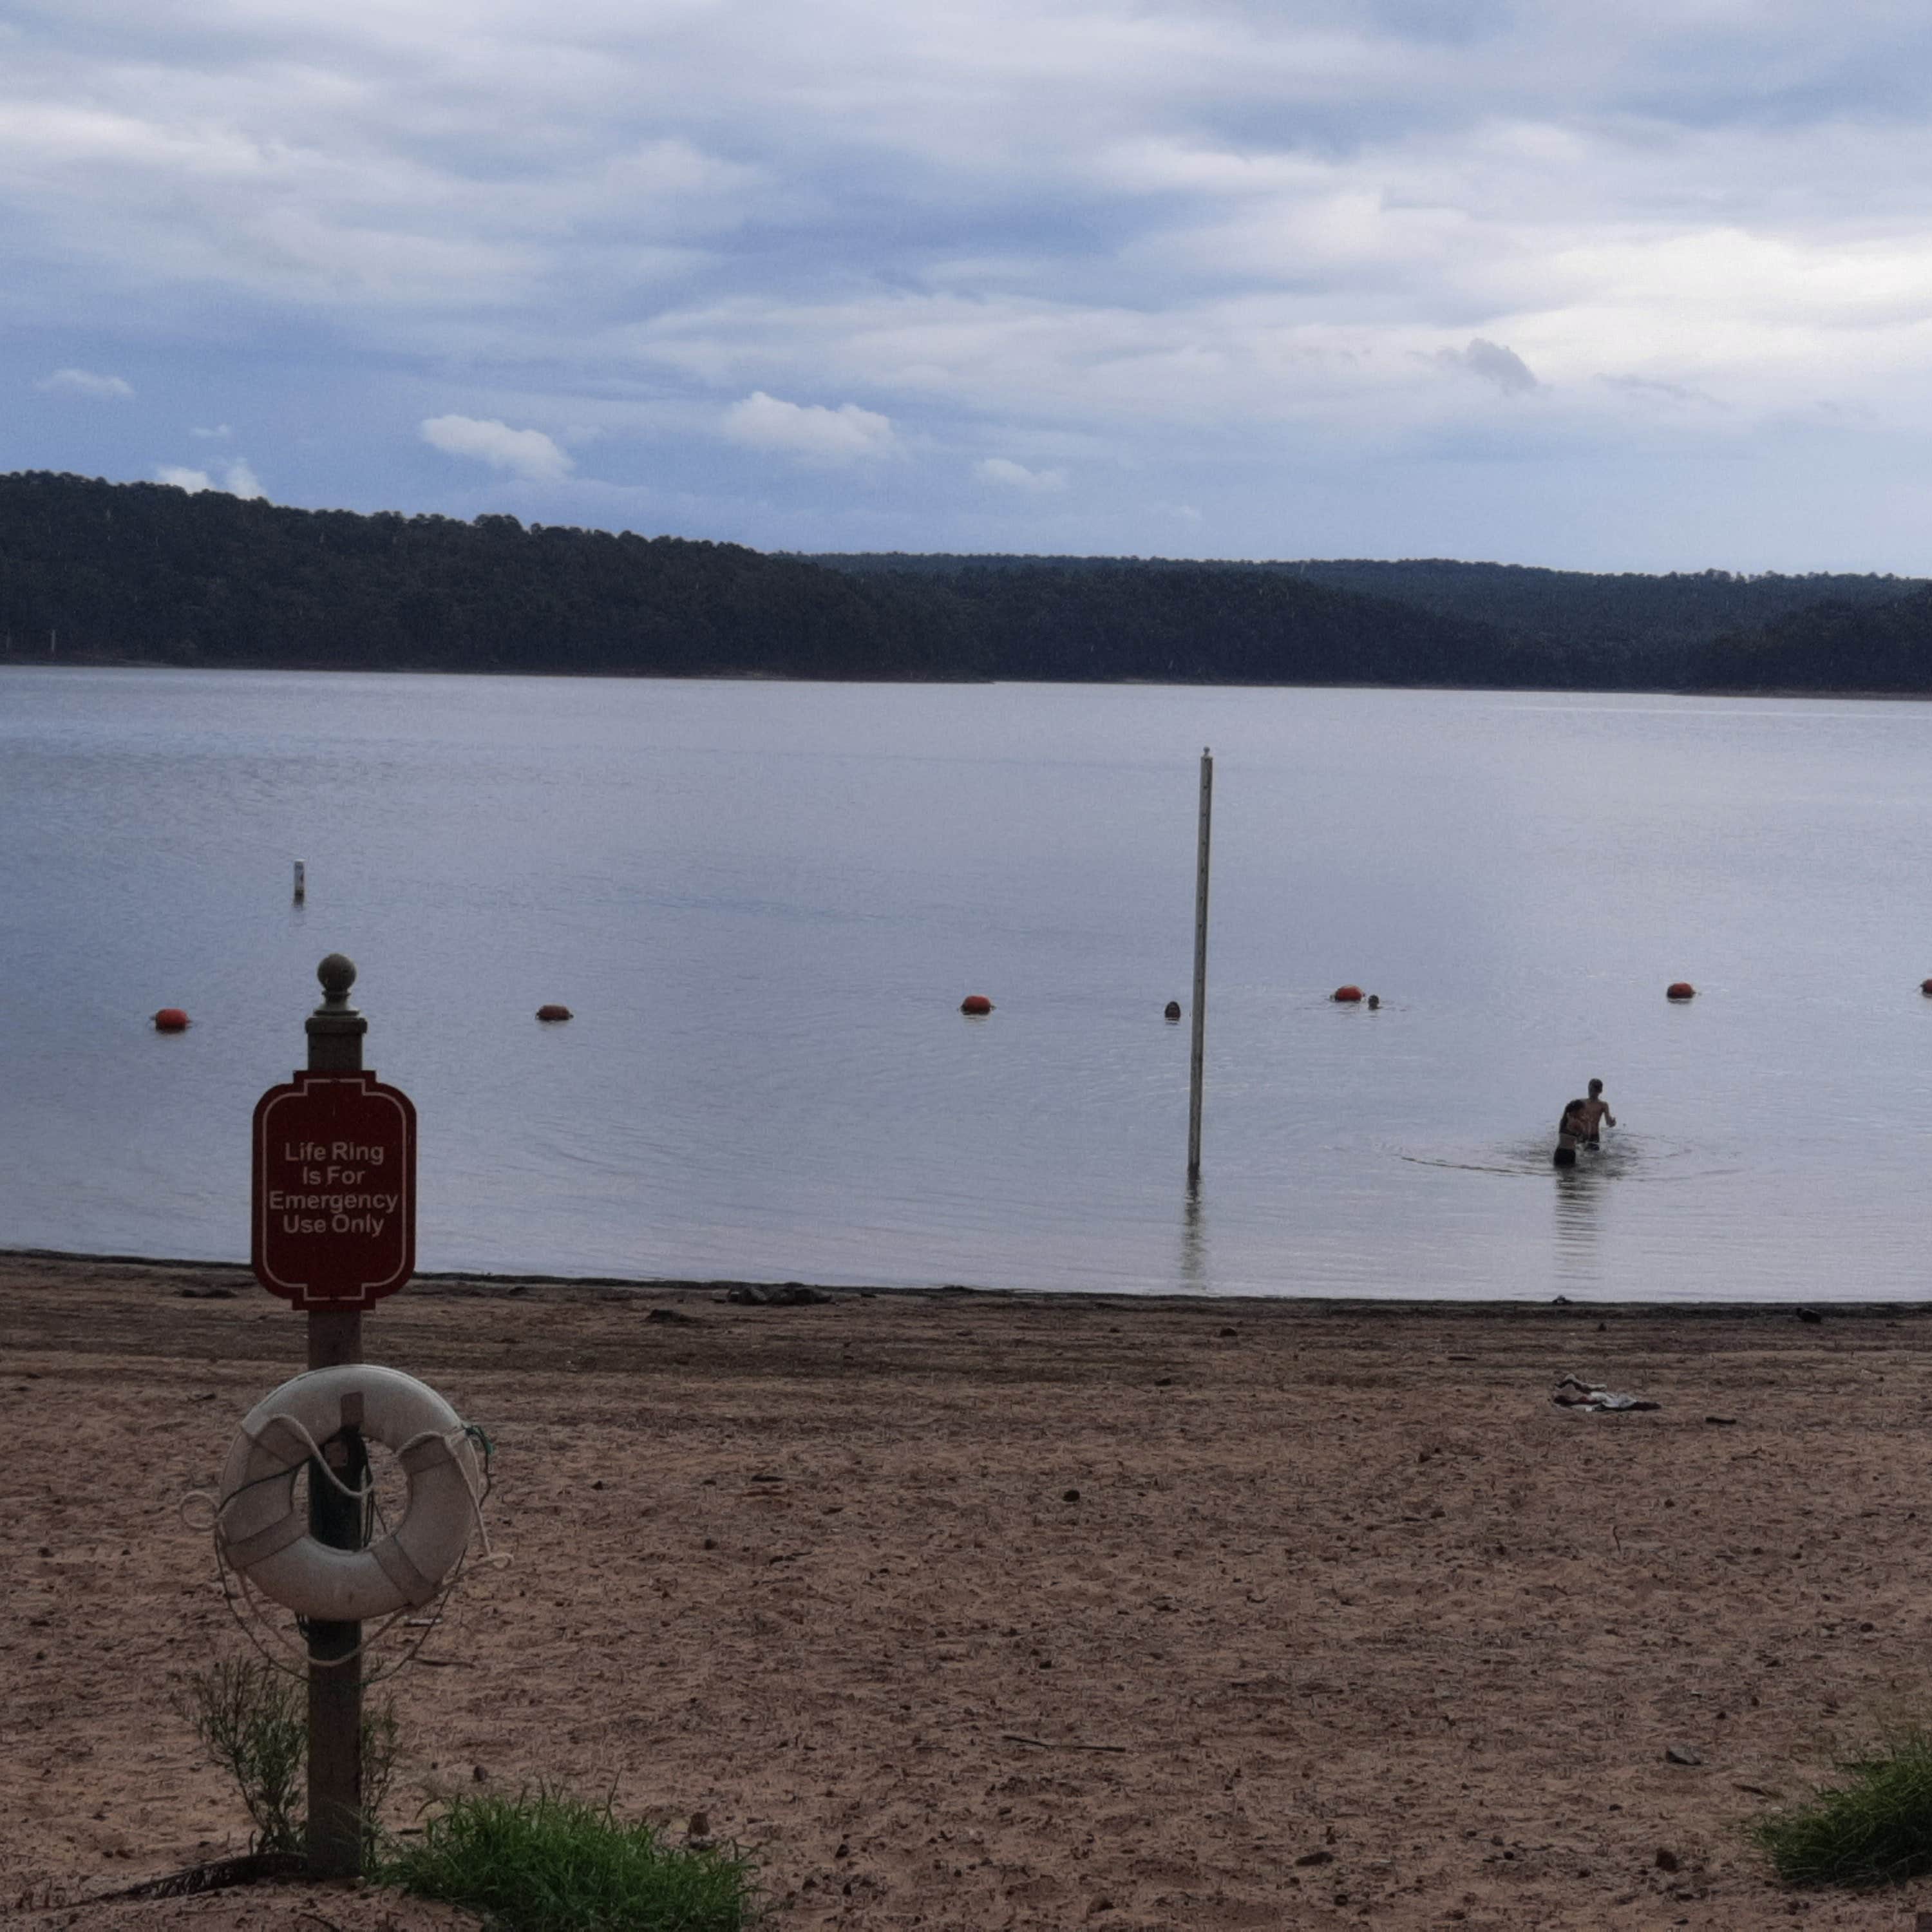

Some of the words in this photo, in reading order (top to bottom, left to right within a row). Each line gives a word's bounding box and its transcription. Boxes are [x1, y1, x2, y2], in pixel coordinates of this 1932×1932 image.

[285, 1142, 326, 1161] Life
[332, 1142, 384, 1165] Ring
[327, 1166, 366, 1185] For
[269, 1190, 398, 1213] Emergency
[283, 1215, 326, 1233] Use
[332, 1213, 384, 1237] Only
